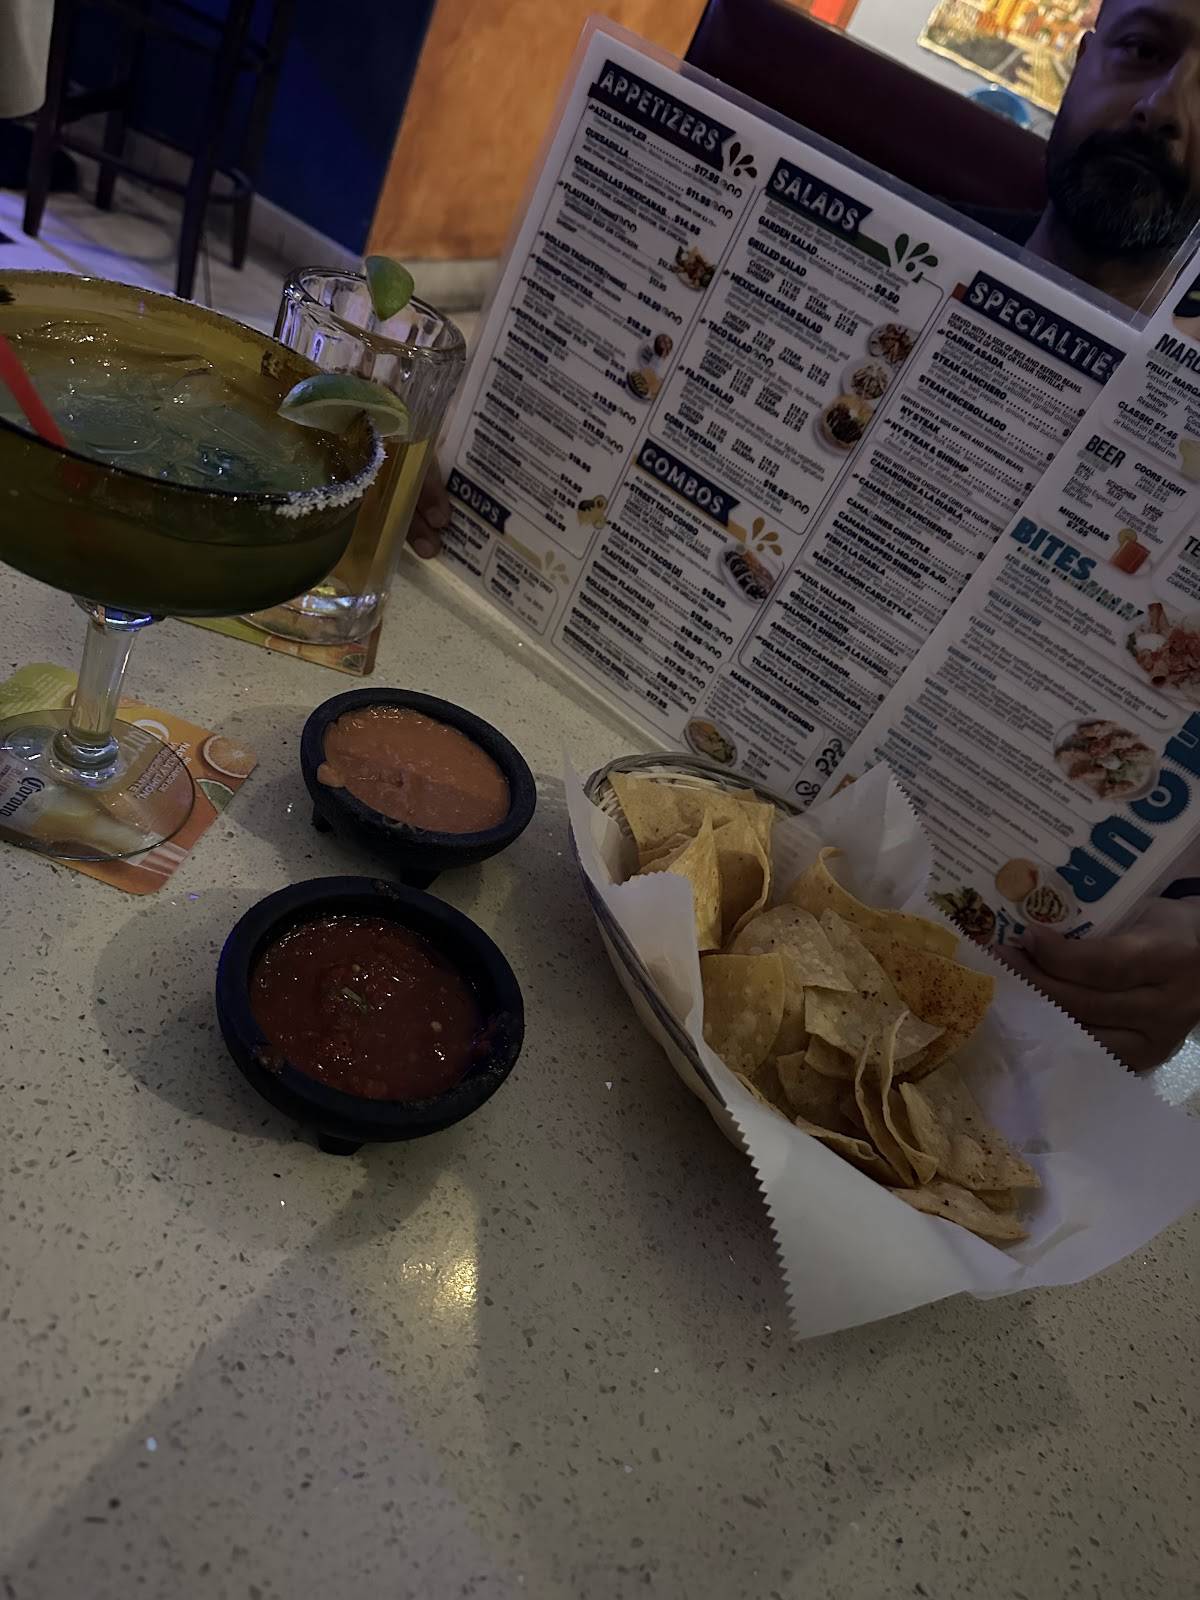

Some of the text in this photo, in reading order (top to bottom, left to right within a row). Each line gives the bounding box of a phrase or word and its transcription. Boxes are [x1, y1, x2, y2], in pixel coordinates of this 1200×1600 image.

[598, 68, 723, 152] APPETIZERS
[770, 166, 862, 233] SALADS
[747, 237, 807, 277] GRILLED SALAD
[757, 216, 791, 240] GARDEN
[789, 234, 817, 256] SALAD
[729, 273, 823, 334] MEXICAN CAESAR SALAD
[706, 320, 752, 354] TACO SALAD
[944, 330, 1004, 370] CARNE ASADA
[982, 339, 991, 349] OF
[1006, 354, 1016, 364] OR
[1003, 343, 1013, 353] OF
[1025, 356, 1039, 369] AND
[683, 368, 734, 405] FAJITA SALAD
[931, 351, 1007, 401] STEAK RANCHERO
[1145, 360, 1172, 380] FRUIT
[899, 405, 940, 434] NY STEAK
[918, 374, 1007, 432] STEAK ENCEBOLLADO
[1117, 400, 1154, 426] CLASSIC
[663, 412, 684, 431] CORN
[684, 426, 717, 452] TOSTADA
[889, 421, 969, 474] NY STEAK & SHRIMP
[1084, 433, 1126, 468] BEER
[446, 474, 502, 524] SOUPS
[639, 446, 727, 515] COMBOS
[869, 457, 964, 520] CAMARONES A LA DIABLA
[1133, 461, 1186, 498] COORS LIGHT
[654, 501, 674, 519] TACO
[845, 496, 930, 555] CAMAONES CHIPOTLE
[857, 476, 953, 540] CAMARONES RANCHEROS
[1058, 505, 1110, 541] MICHELADAS
[823, 532, 886, 577] FISH A LA DIABLA
[831, 519, 858, 540] BACON
[856, 534, 893, 562] WRAPPED
[837, 510, 886, 546] CAMARONES
[928, 568, 947, 585] AJO
[1010, 516, 1097, 581] BITES
[799, 571, 857, 613] AZUL VALLARTA
[811, 551, 913, 621] BABY SALMON CABO STYLE
[781, 601, 813, 627] SALMON
[844, 643, 851, 652] A
[850, 647, 862, 659] LA
[788, 590, 849, 634] GRILLED SALMON
[760, 638, 776, 653] DEL
[774, 647, 792, 664] MAR
[790, 658, 821, 683] CORTEZ
[769, 620, 850, 679] ARROZ CON CAMARON
[728, 669, 815, 732] MAKE YOUR OWN COMBO
